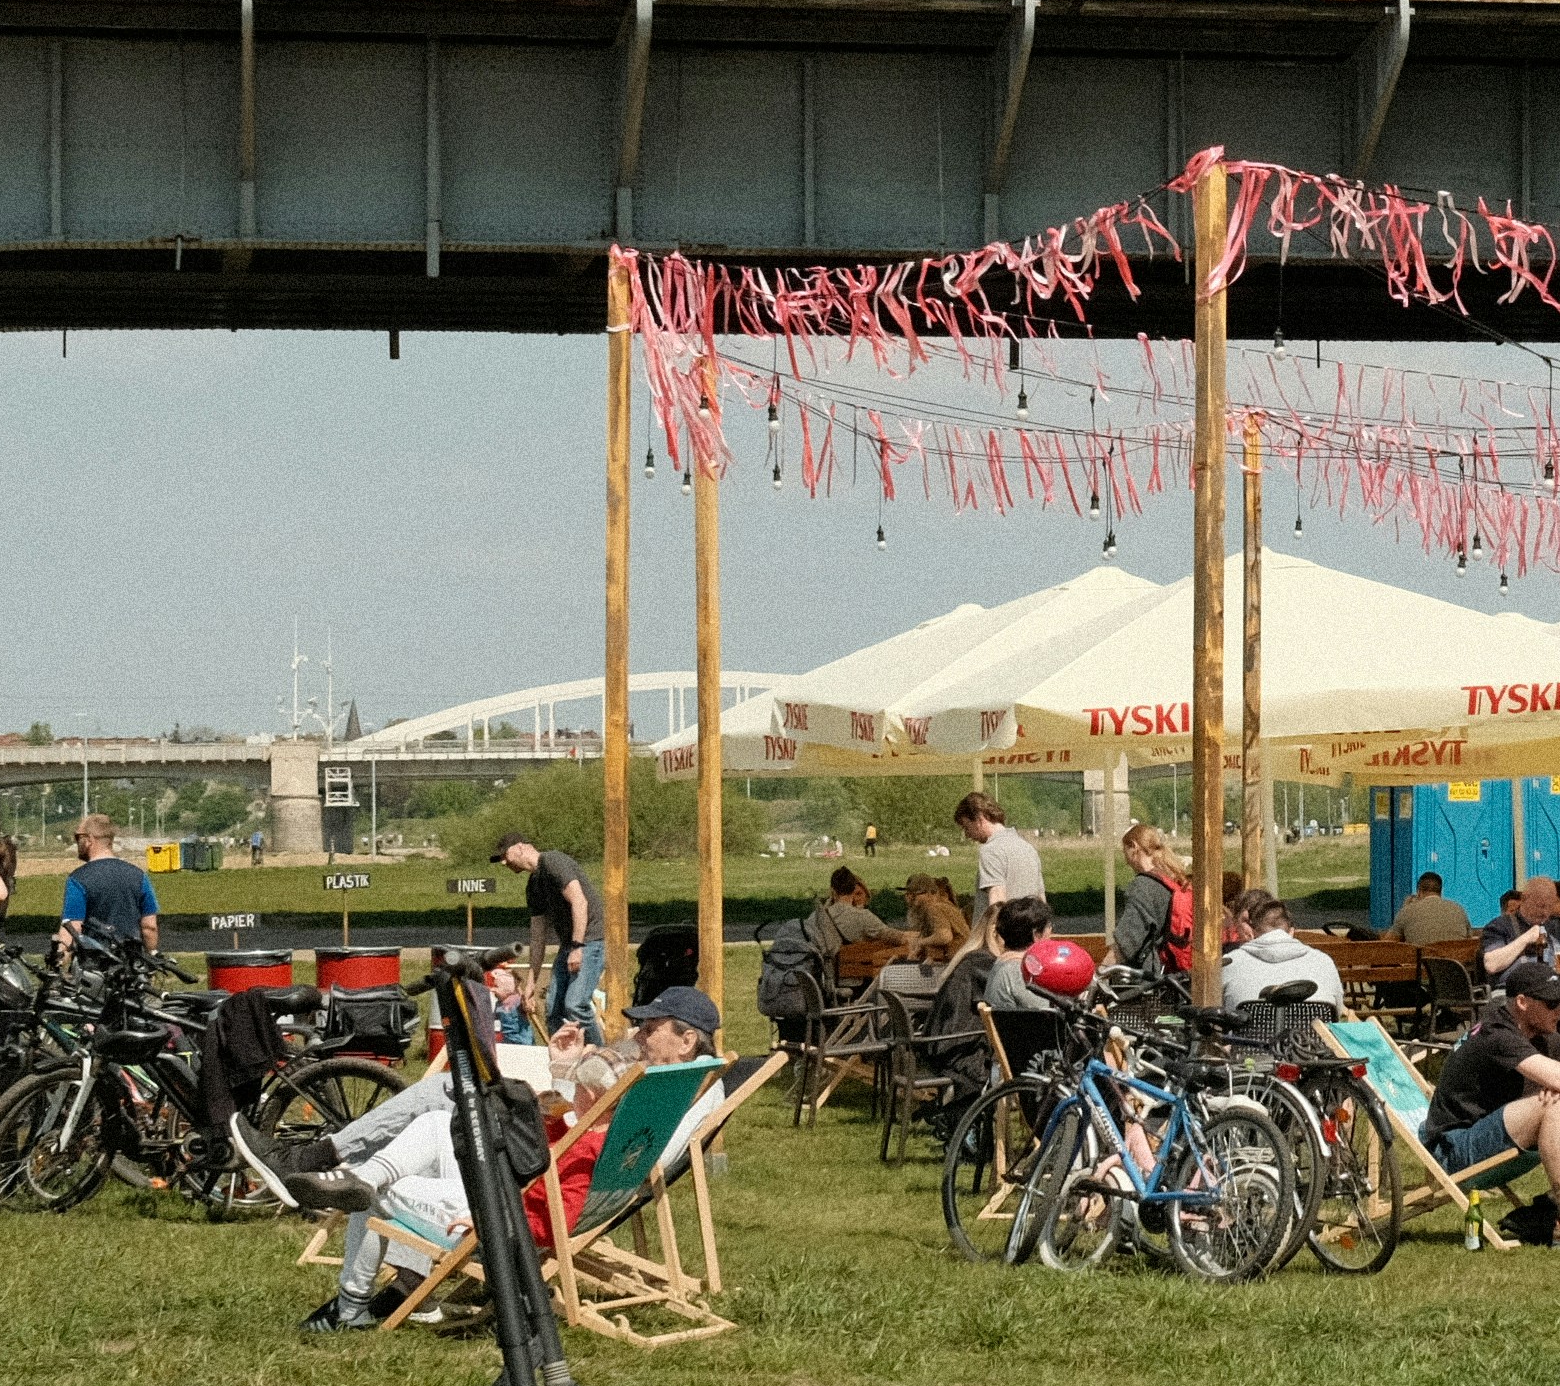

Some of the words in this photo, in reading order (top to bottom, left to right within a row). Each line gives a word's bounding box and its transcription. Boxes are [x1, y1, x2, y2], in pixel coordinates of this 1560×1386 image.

[1083, 702, 1190, 736] TYSKI
[326, 874, 370, 889] PLASTIK
[457, 879, 487, 893] INNE
[211, 914, 255, 930] PAPIER
